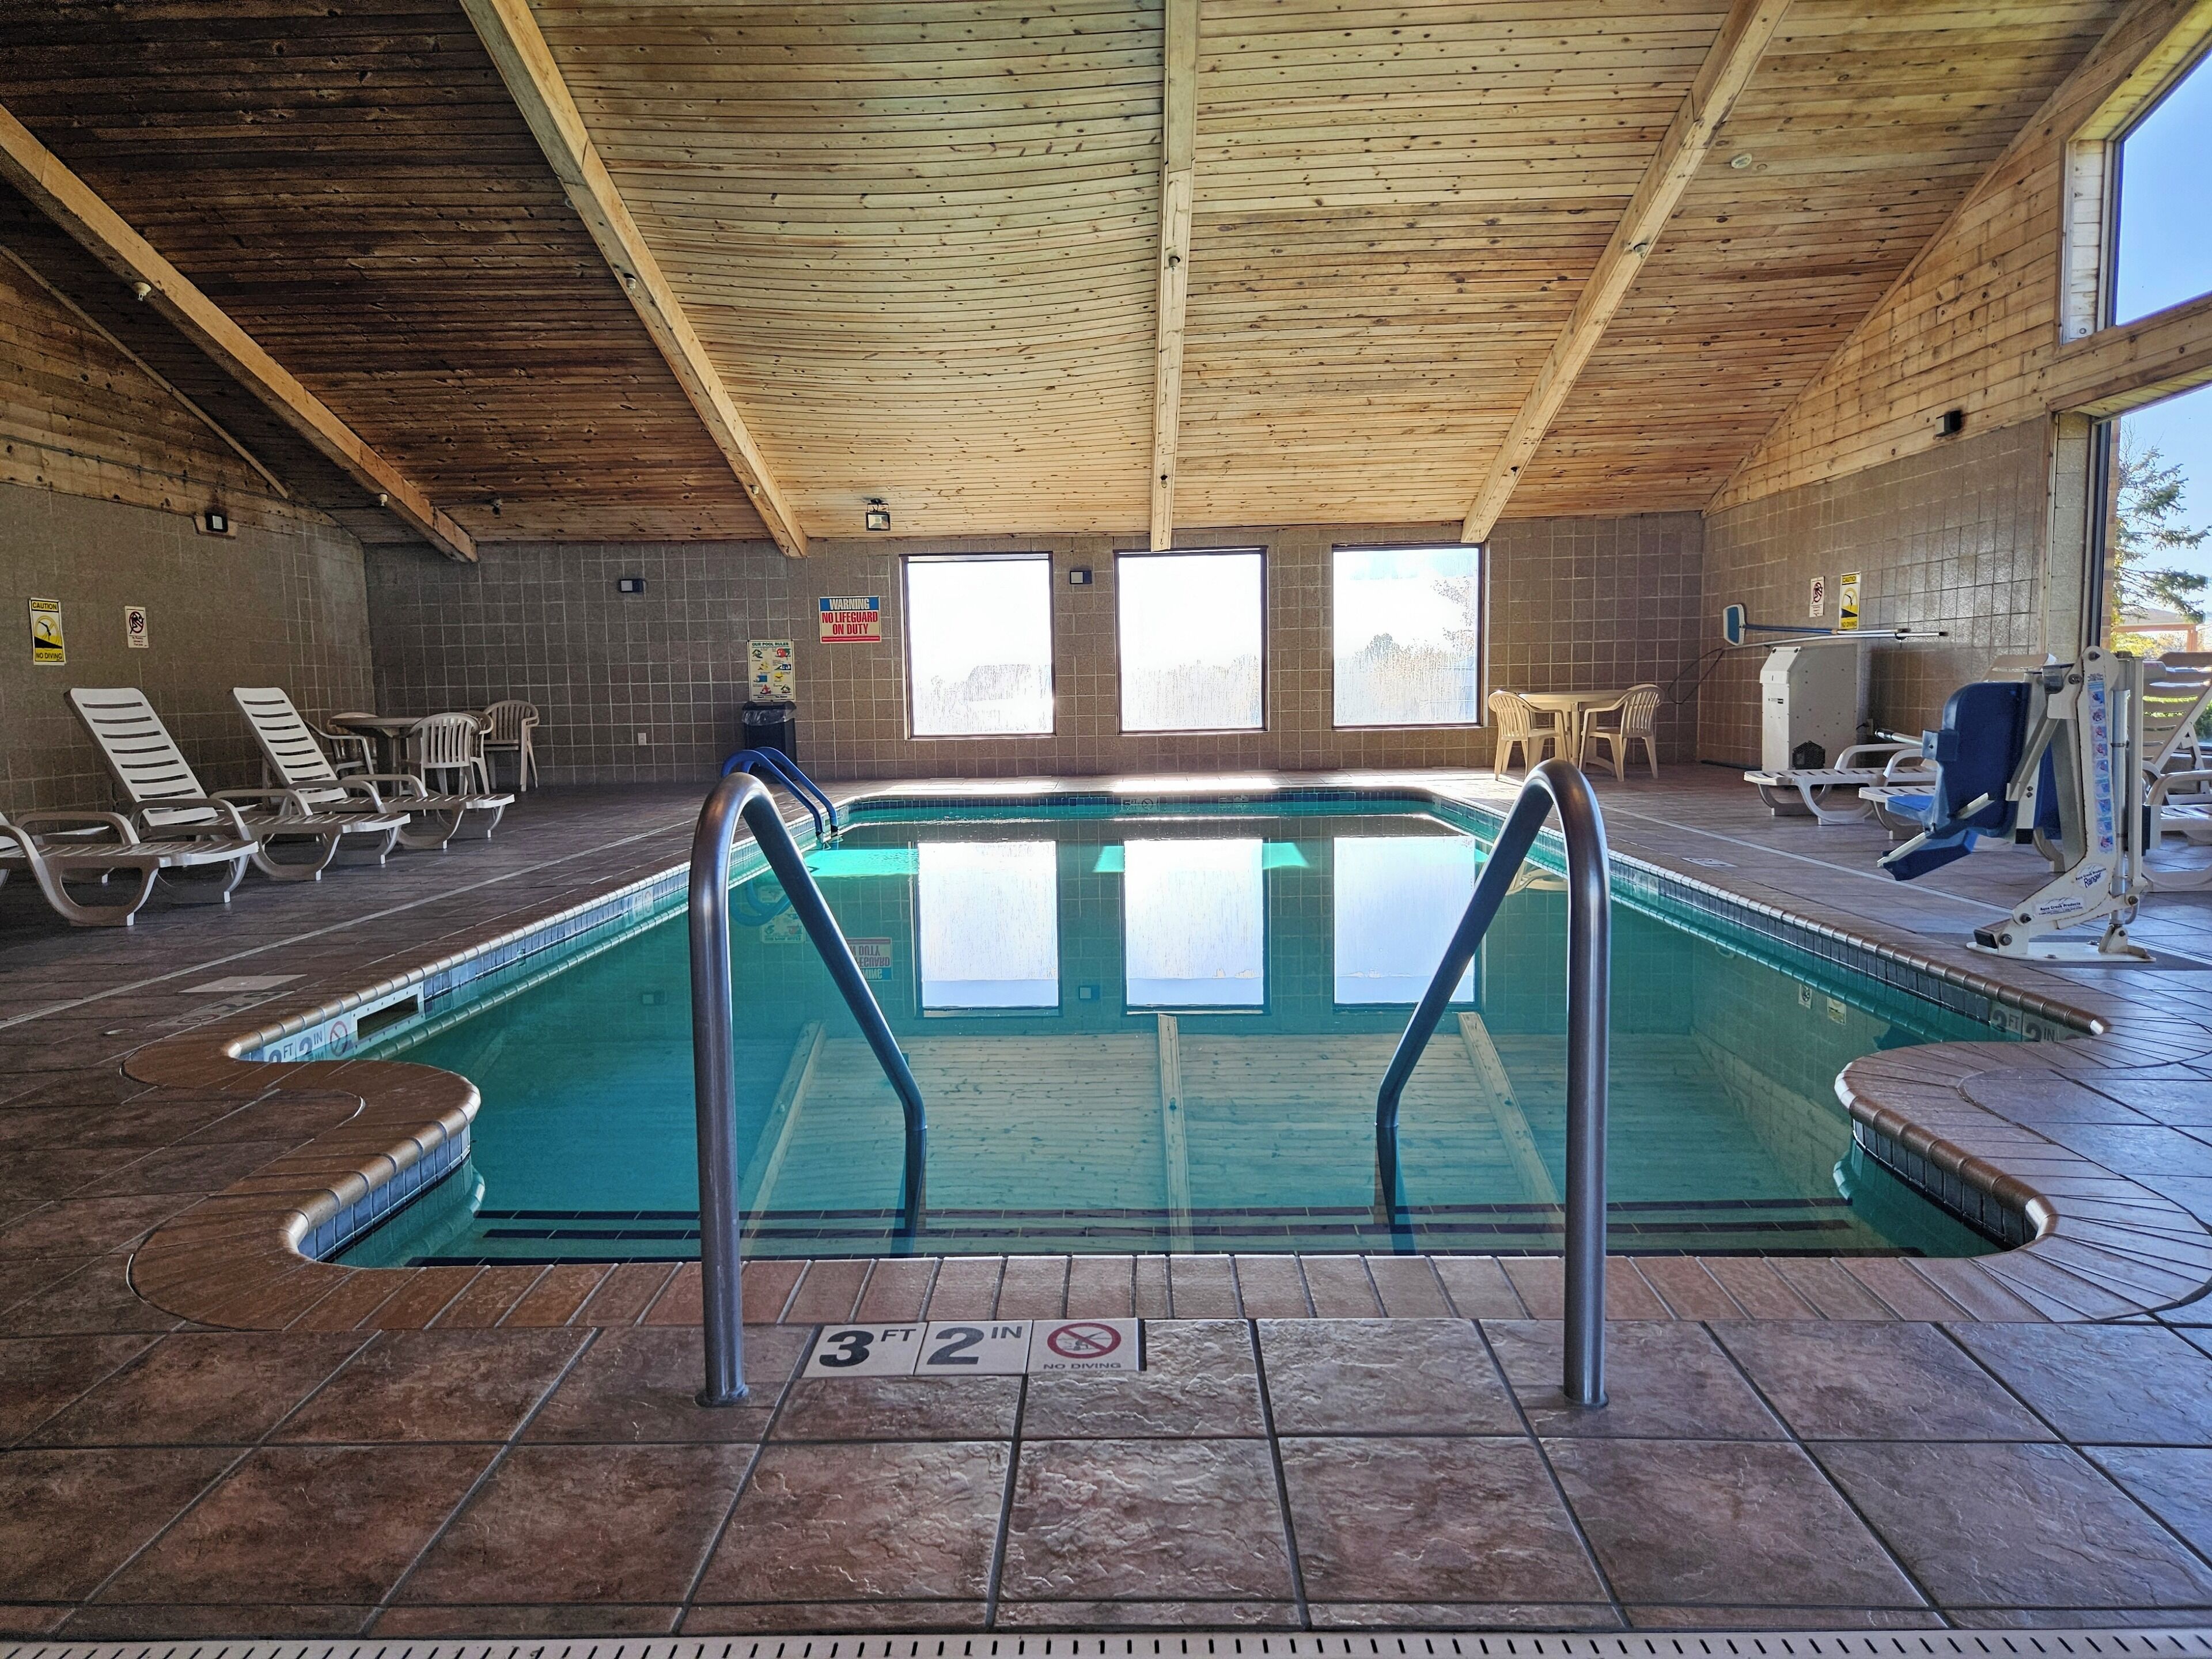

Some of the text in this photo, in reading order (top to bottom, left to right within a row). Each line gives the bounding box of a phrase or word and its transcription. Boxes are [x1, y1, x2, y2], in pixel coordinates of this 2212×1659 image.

[32, 602, 57, 610] CAUTION
[830, 598, 870, 610] WARNING
[822, 611, 878, 623] NO LIFEGUARD
[832, 623, 869, 635] ON DUTY
[2084, 872, 2101, 888] Ranger
[2009, 1014, 2020, 1031] FT
[2044, 1028, 2055, 1042] IN
[283, 1043, 293, 1059] FT
[313, 1031, 323, 1045] IN
[819, 1326, 1023, 1368] 3 FT 2 IN
